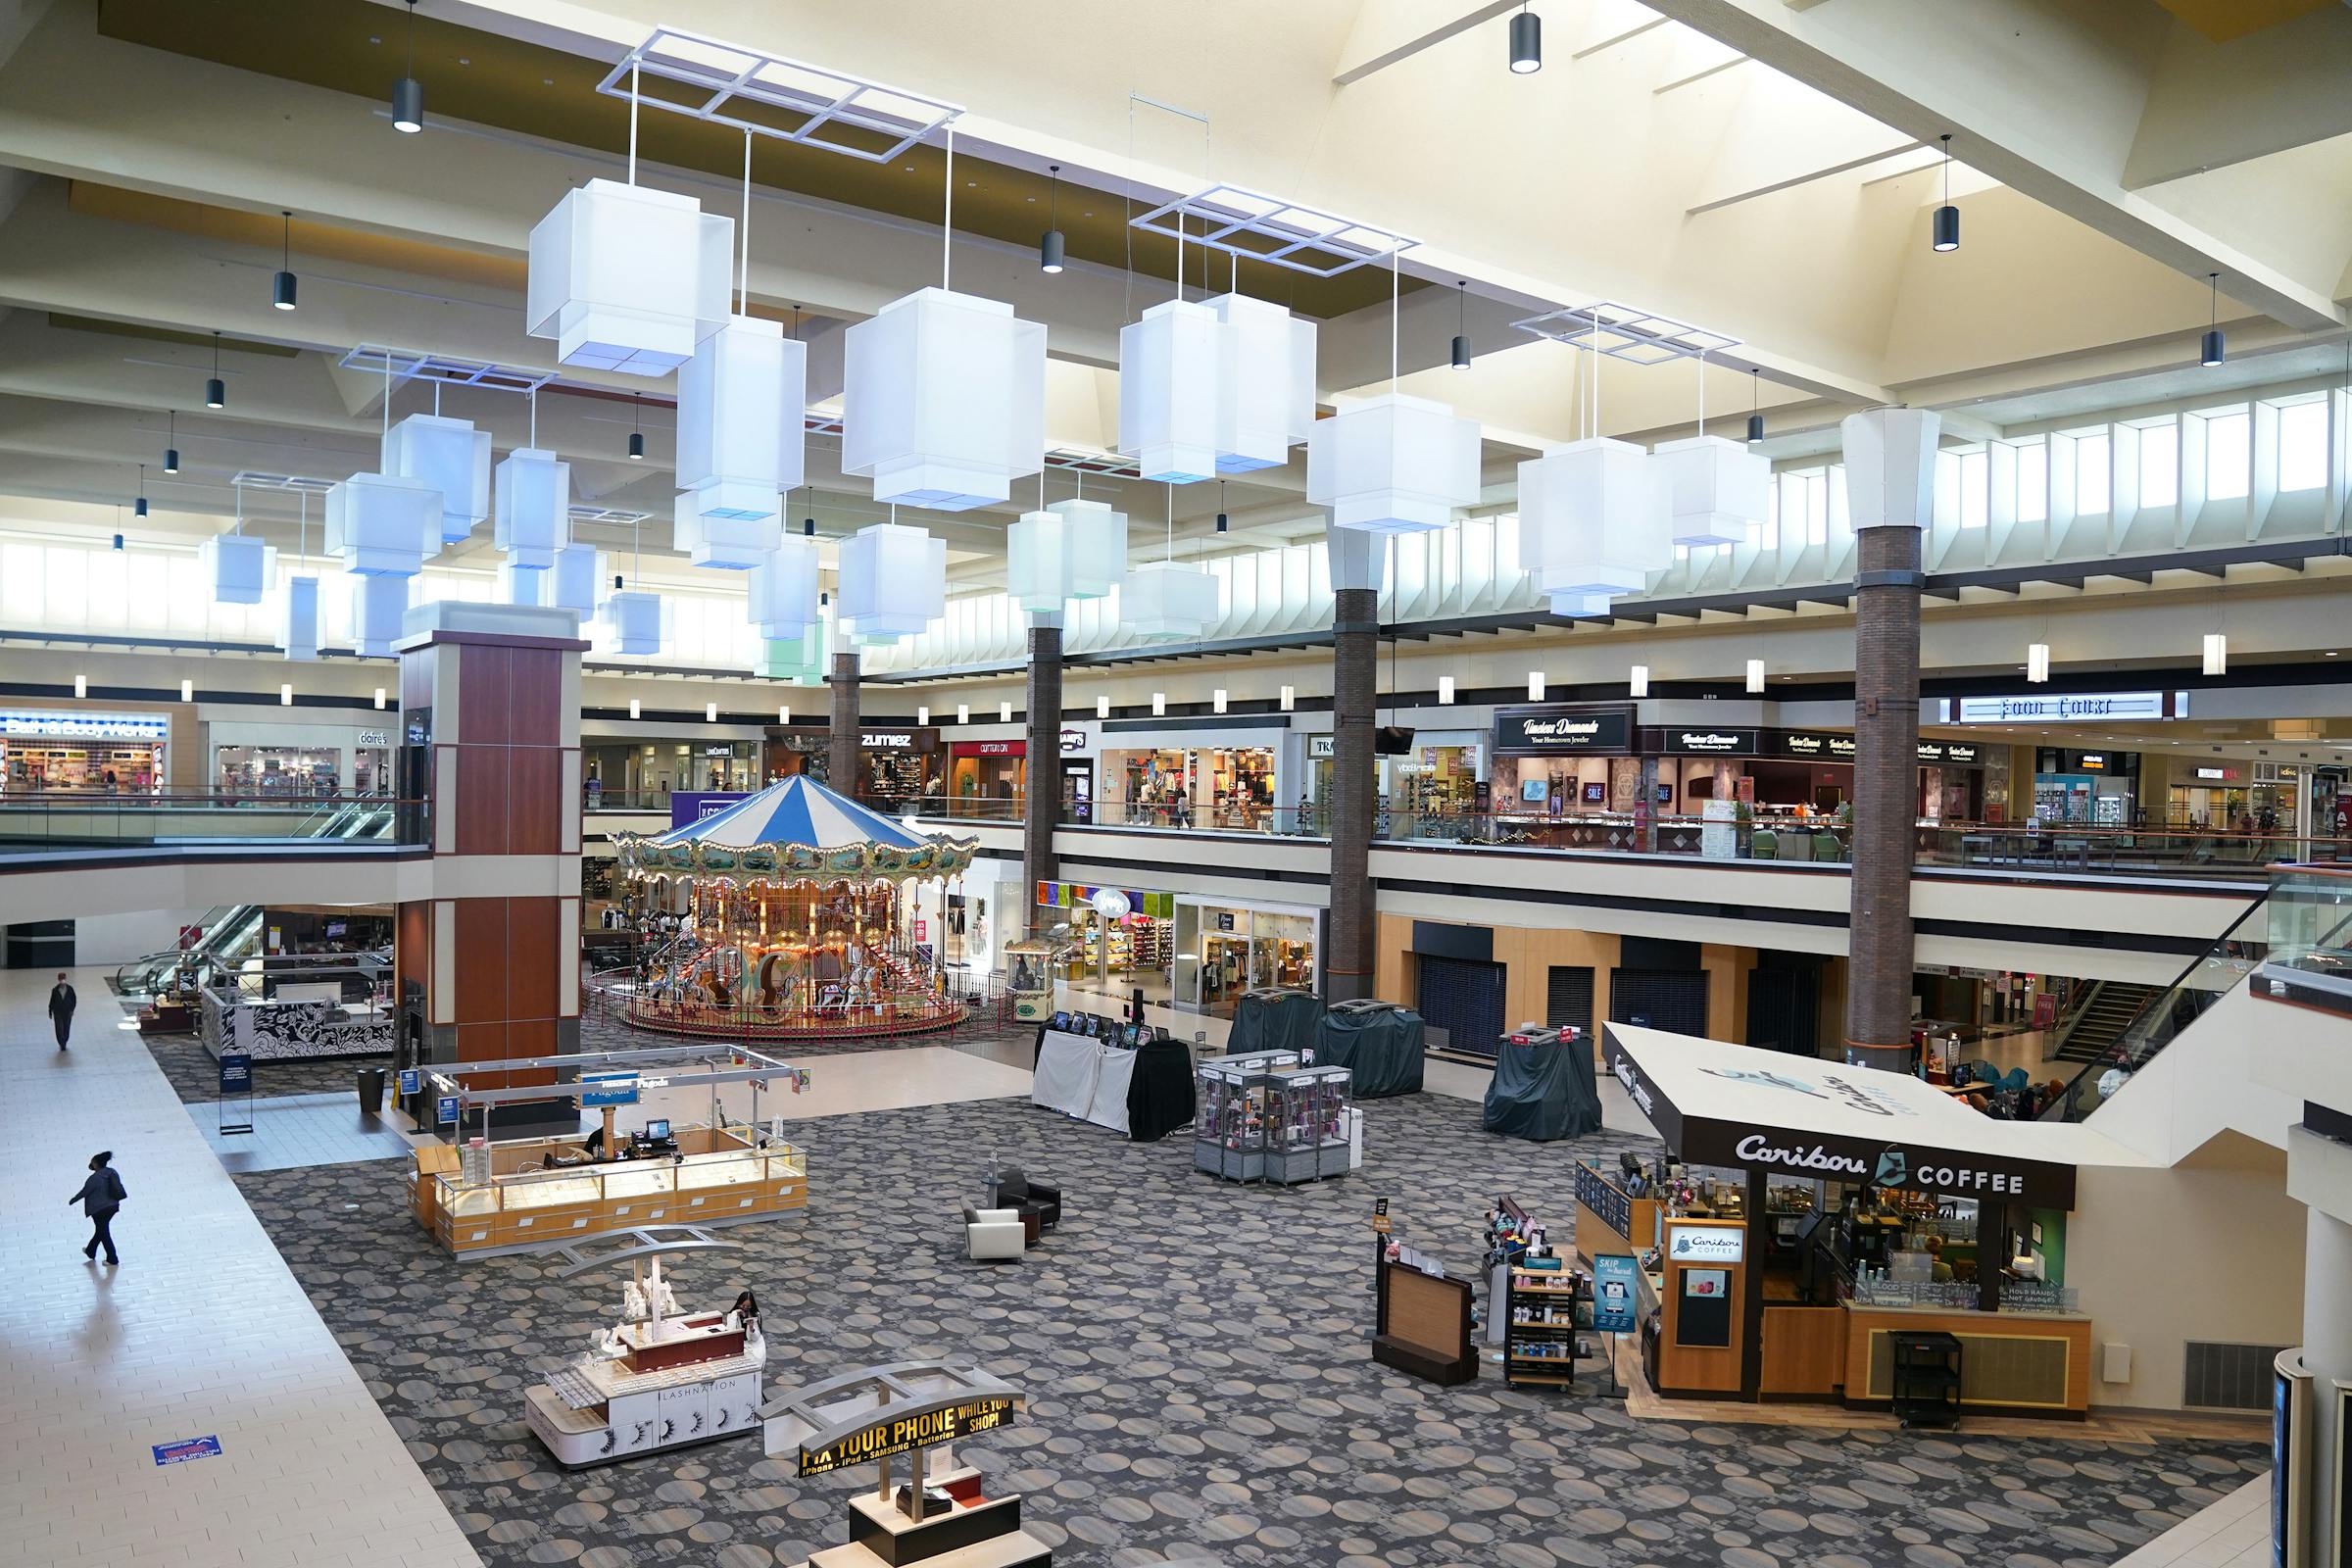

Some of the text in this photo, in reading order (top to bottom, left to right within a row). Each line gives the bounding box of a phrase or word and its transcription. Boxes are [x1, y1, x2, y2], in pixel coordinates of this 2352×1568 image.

[1999, 697, 2112, 719] FOOD COURT
[6, 719, 47, 734] Bath
[62, 721, 102, 738] Body
[101, 722, 159, 737] Works
[1523, 718, 1599, 735] Timeless Diamonds
[360, 729, 388, 746] claire's
[1571, 736, 1590, 745] Jeweler
[980, 744, 1008, 753] COTTON ON
[1588, 788, 1601, 799] SALE
[636, 1077, 668, 1089] Pagoda
[1736, 1135, 2024, 1196] Caribou COFFEE
[1691, 1236, 1740, 1247] Caribou
[1599, 1258, 1619, 1268] SKIP
[662, 1380, 736, 1401] LASHNATION
[957, 1401, 989, 1420] WHILE
[969, 1412, 1000, 1433] SHOP!
[838, 1426, 888, 1457] YOUR
[894, 1407, 956, 1445] PHONE
[802, 1462, 834, 1476] iPhone
[869, 1442, 909, 1459] SAMSUNG
[917, 1430, 956, 1446] Batteries
